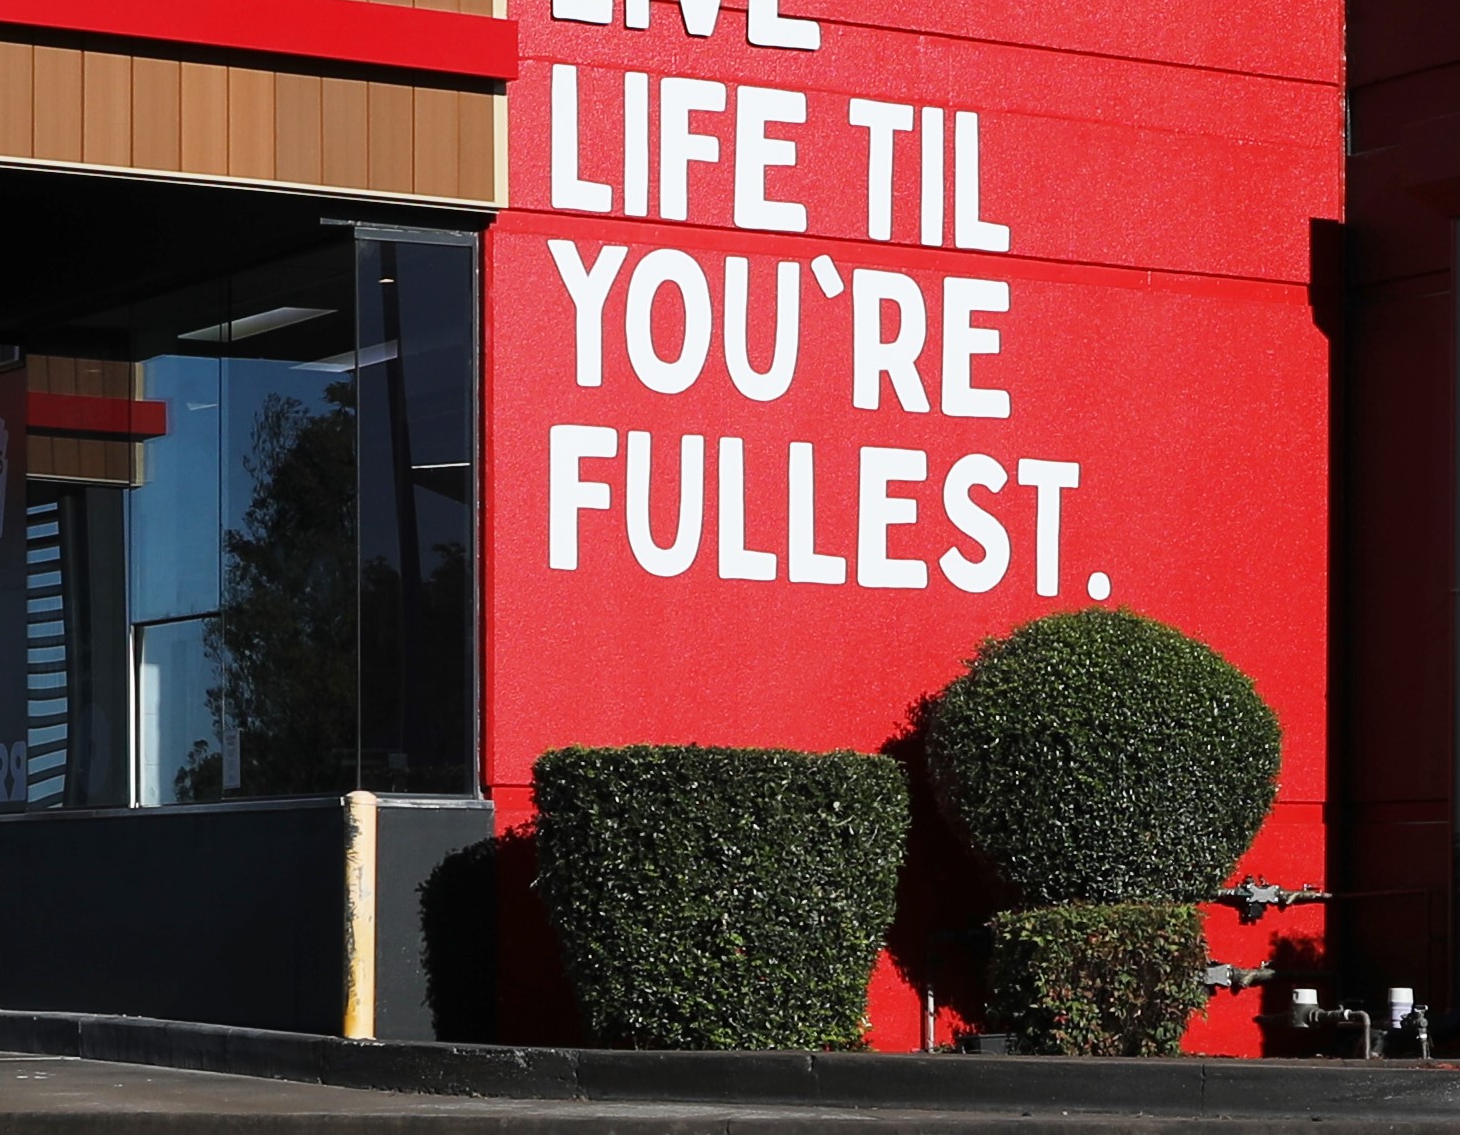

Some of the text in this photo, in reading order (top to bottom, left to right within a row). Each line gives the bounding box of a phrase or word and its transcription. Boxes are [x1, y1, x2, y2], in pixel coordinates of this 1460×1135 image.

[550, 63, 1011, 253] LIFE TIL
[548, 424, 1113, 601] FULLEST.
